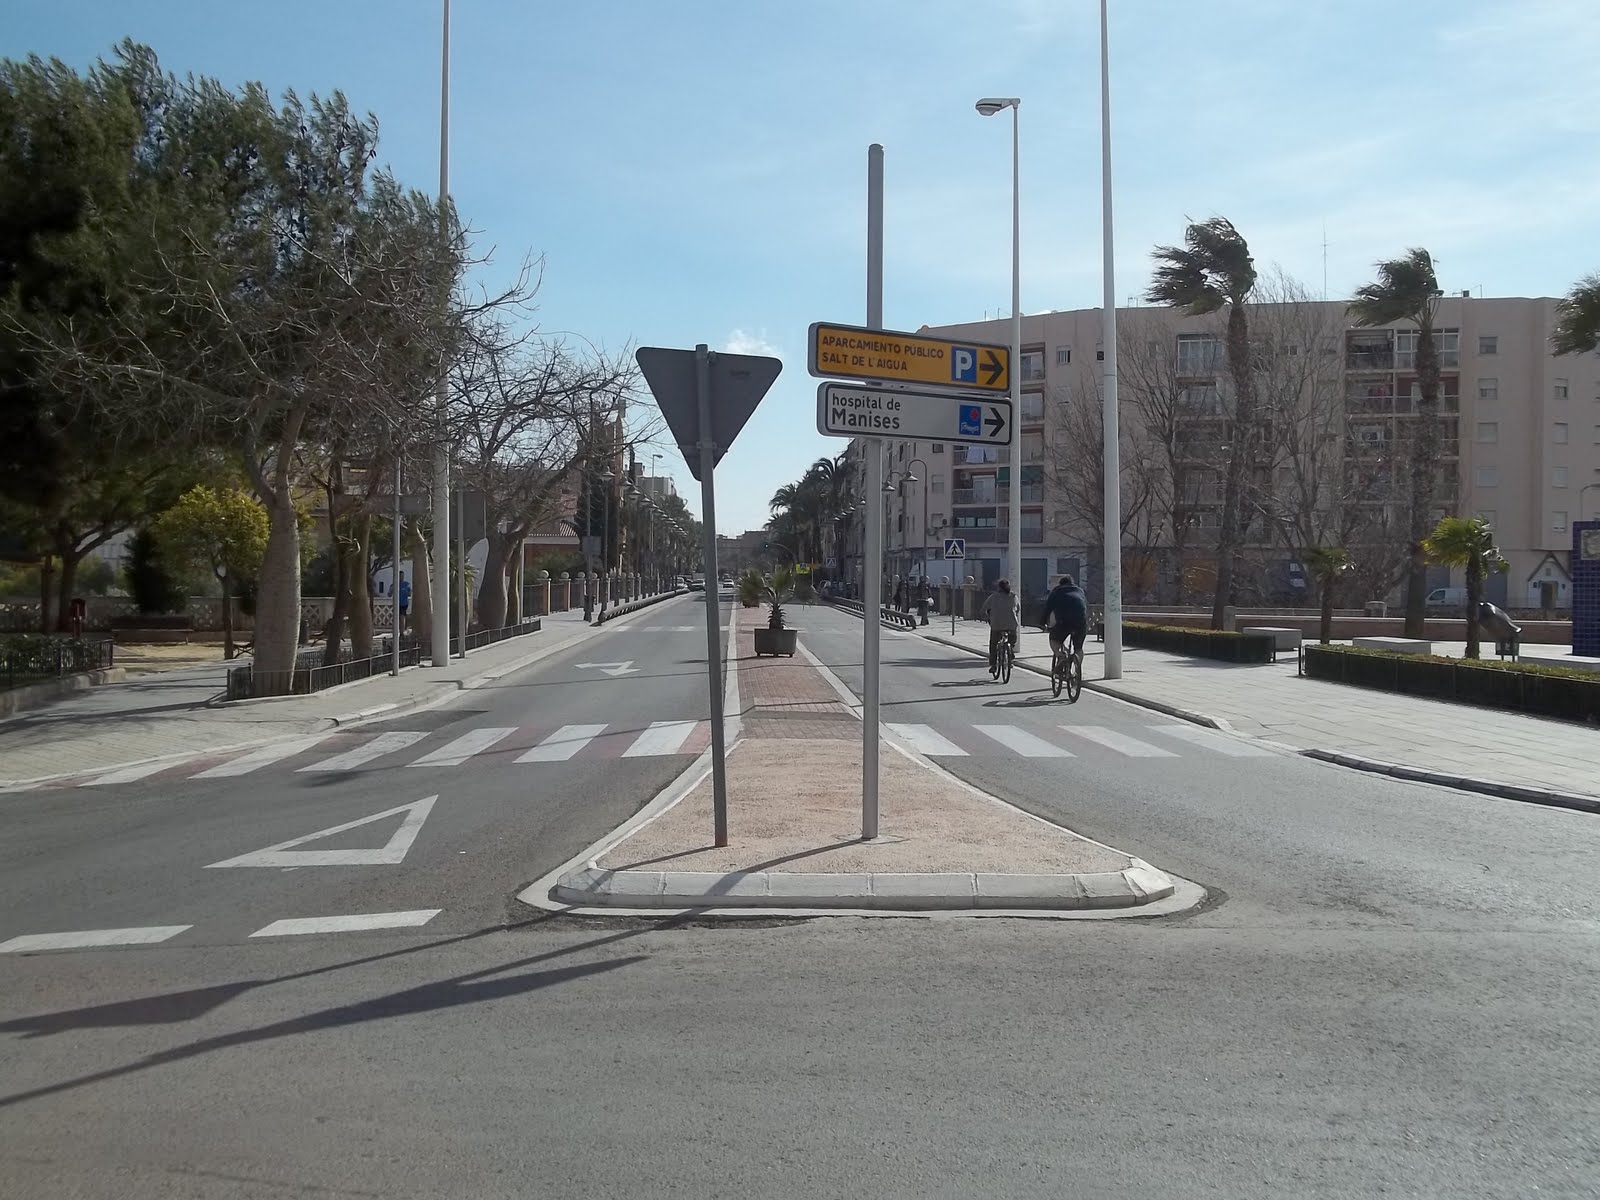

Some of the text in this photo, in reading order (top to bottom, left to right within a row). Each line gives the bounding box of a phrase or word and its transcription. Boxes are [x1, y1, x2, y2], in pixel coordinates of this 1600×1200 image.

[822, 335, 901, 354] APARCAMIENTO
[822, 352, 849, 365] SALT
[852, 355, 865, 367] DE
[955, 350, 973, 379] P
[832, 392, 901, 411] hospital de
[831, 408, 900, 430] Manises
